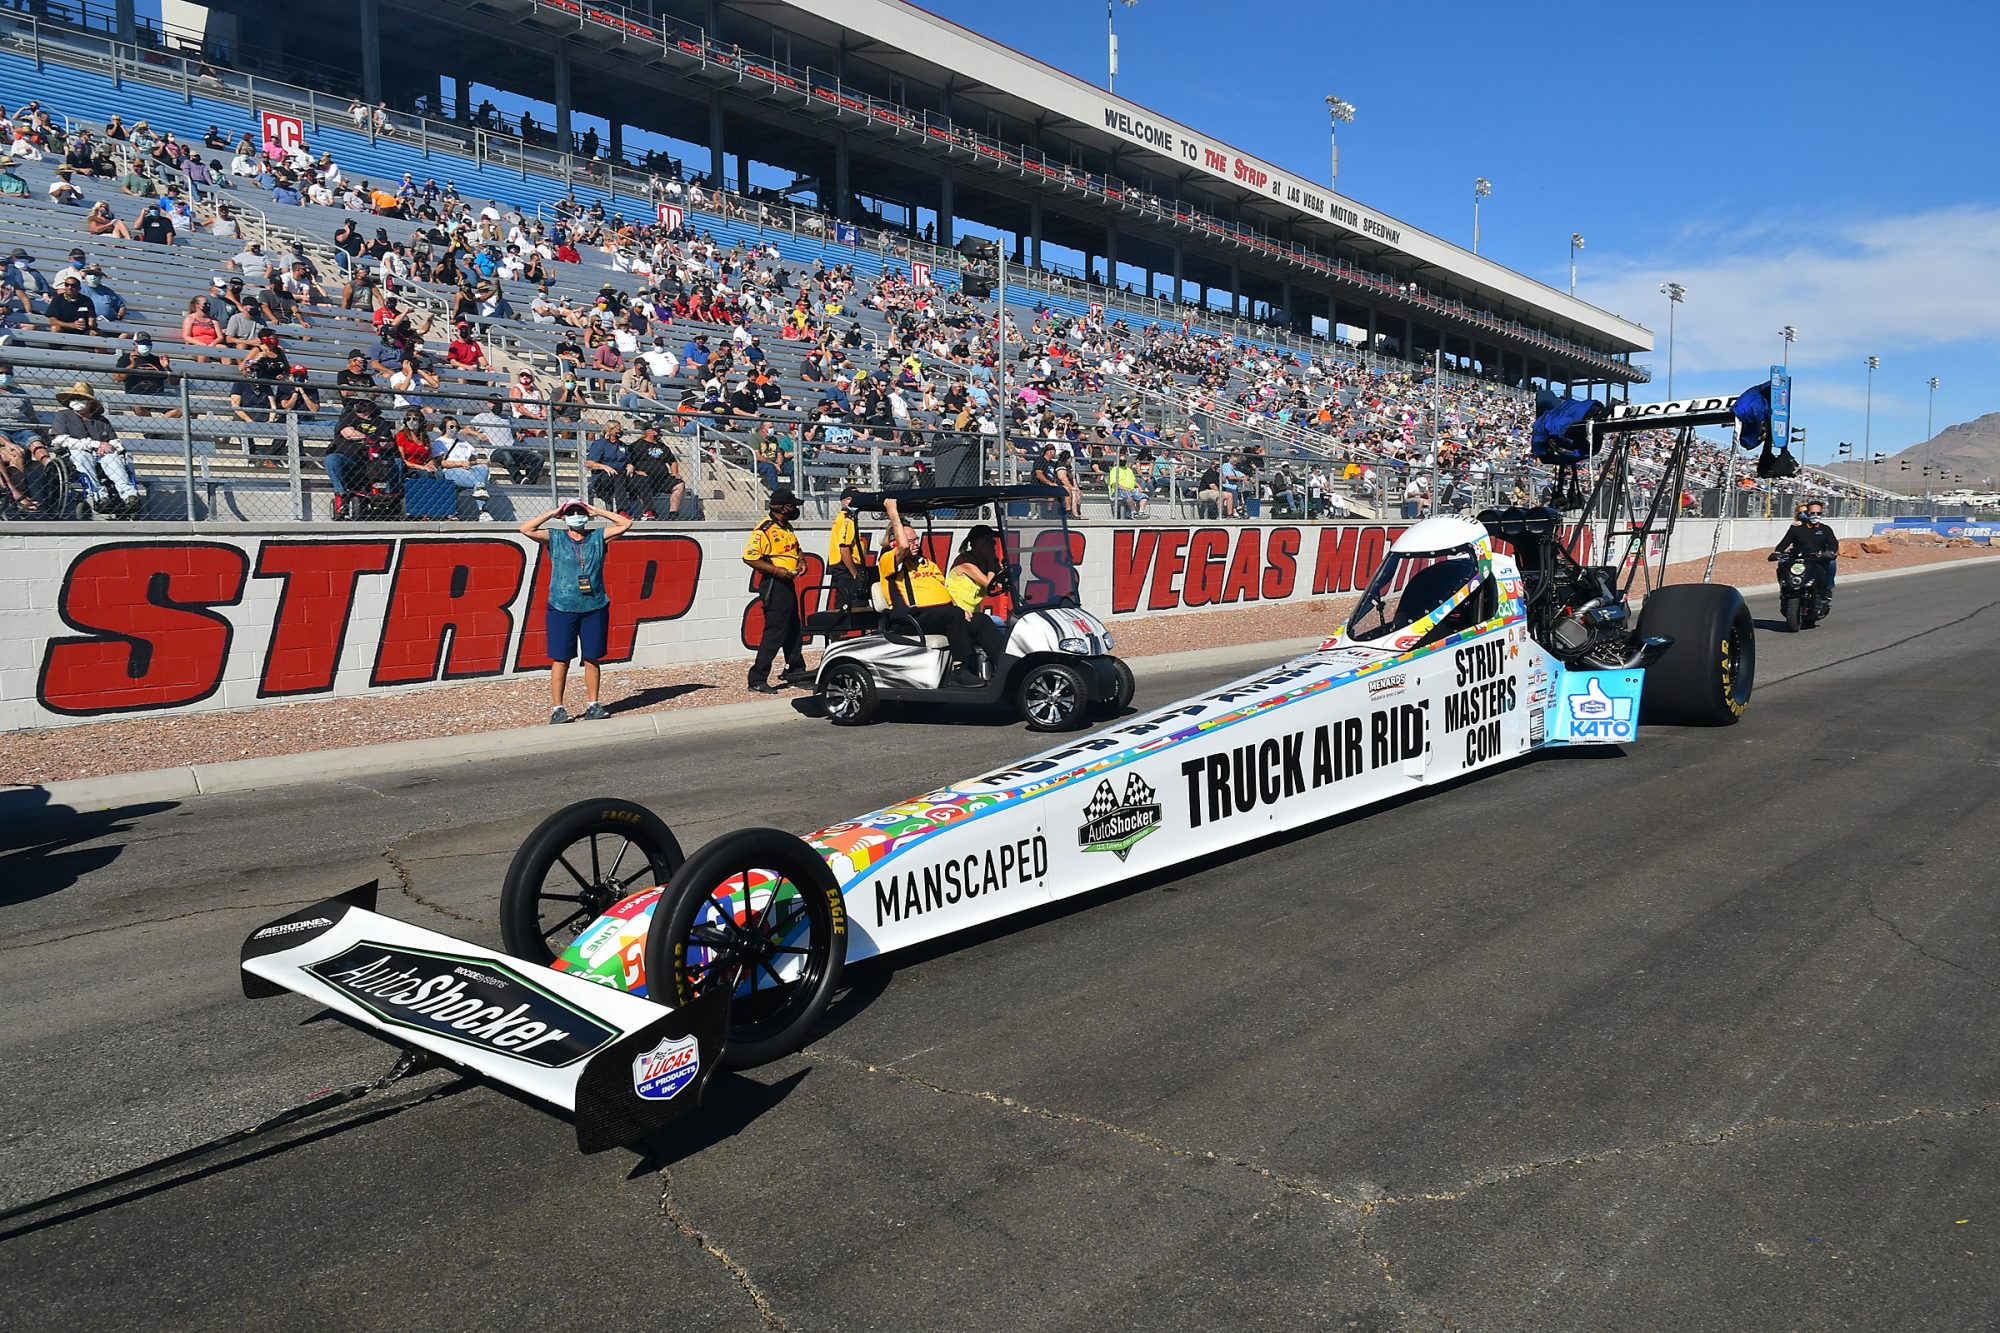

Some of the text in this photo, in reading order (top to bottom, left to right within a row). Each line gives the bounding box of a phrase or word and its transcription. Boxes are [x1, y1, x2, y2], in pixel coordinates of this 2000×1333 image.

[1104, 108, 1401, 245] WELCOME TO THE STRIP at LAS VEGAS MOTOR SPEEDWAY
[1111, 527, 1302, 614] VEGAS
[1368, 673, 1406, 693] MENARDS
[1455, 639, 1506, 687] STRUT
[1444, 675, 1517, 734] MASTERS
[1462, 720, 1501, 768] .COM
[1570, 721, 1631, 737] KATO
[1181, 731, 1306, 828] TRUCK
[1312, 715, 1363, 789] AIR
[1088, 810, 1154, 843] AutoShocker
[874, 835, 1048, 927] MANSCAPED
[260, 918, 325, 936] AERODINE
[825, 888, 845, 935] EAGLE
[587, 925, 618, 952] LINE
[328, 955, 570, 1052] AutoShocker
[640, 1065, 696, 1093] OIL PRODUCTS
[643, 1048, 694, 1081] LUCAS
